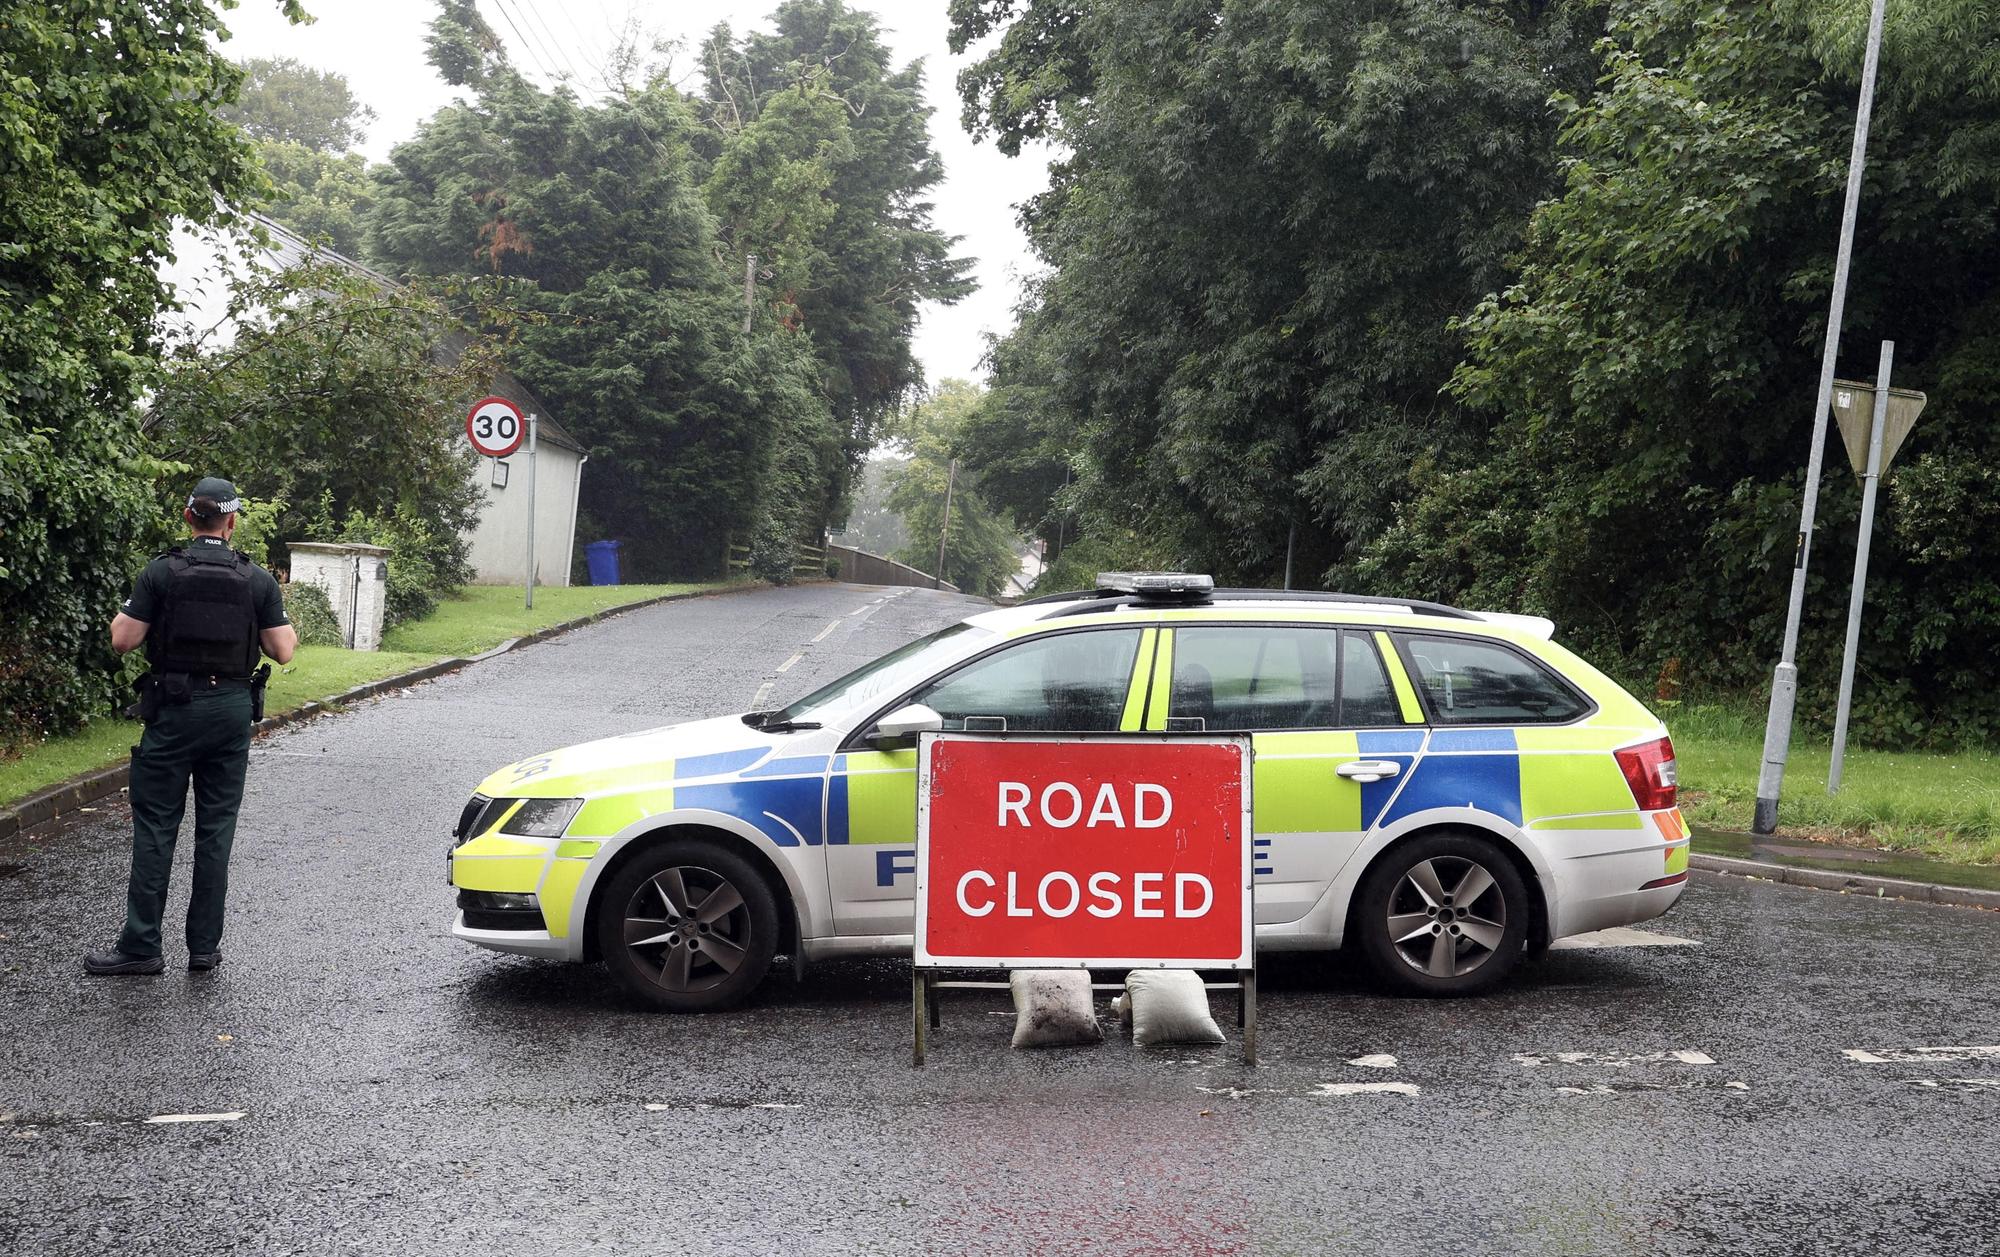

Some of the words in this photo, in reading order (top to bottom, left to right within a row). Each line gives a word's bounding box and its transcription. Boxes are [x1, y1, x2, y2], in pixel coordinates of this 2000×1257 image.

[475, 415, 516, 439] 30
[997, 781, 1173, 828] ROAD
[955, 870, 1214, 919] CLOSED
